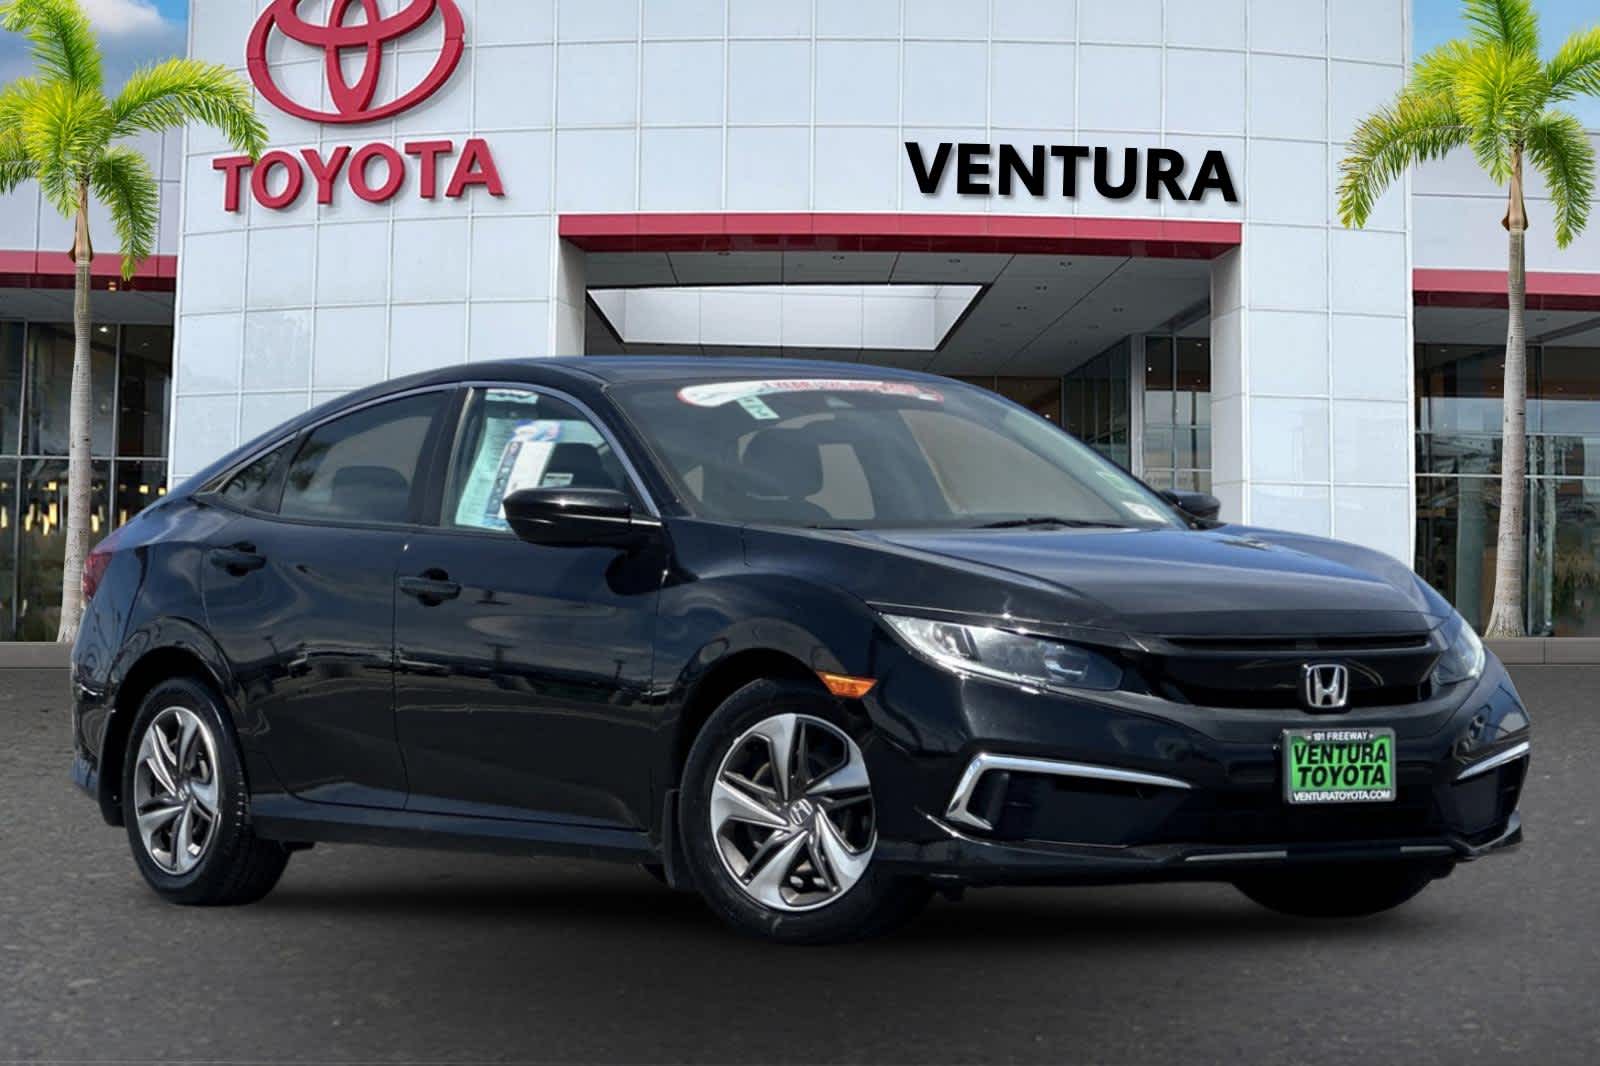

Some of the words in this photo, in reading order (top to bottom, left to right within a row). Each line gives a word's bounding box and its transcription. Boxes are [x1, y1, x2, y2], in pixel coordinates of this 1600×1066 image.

[213, 138, 504, 212] TOYOTA
[904, 141, 1238, 203] VENTURA
[1327, 731, 1368, 741] FREEWAY
[1294, 743, 1387, 764] VENTURA
[1298, 766, 1386, 787] TOYOTA
[1294, 790, 1391, 801] VENTURATOYOTA.COM
